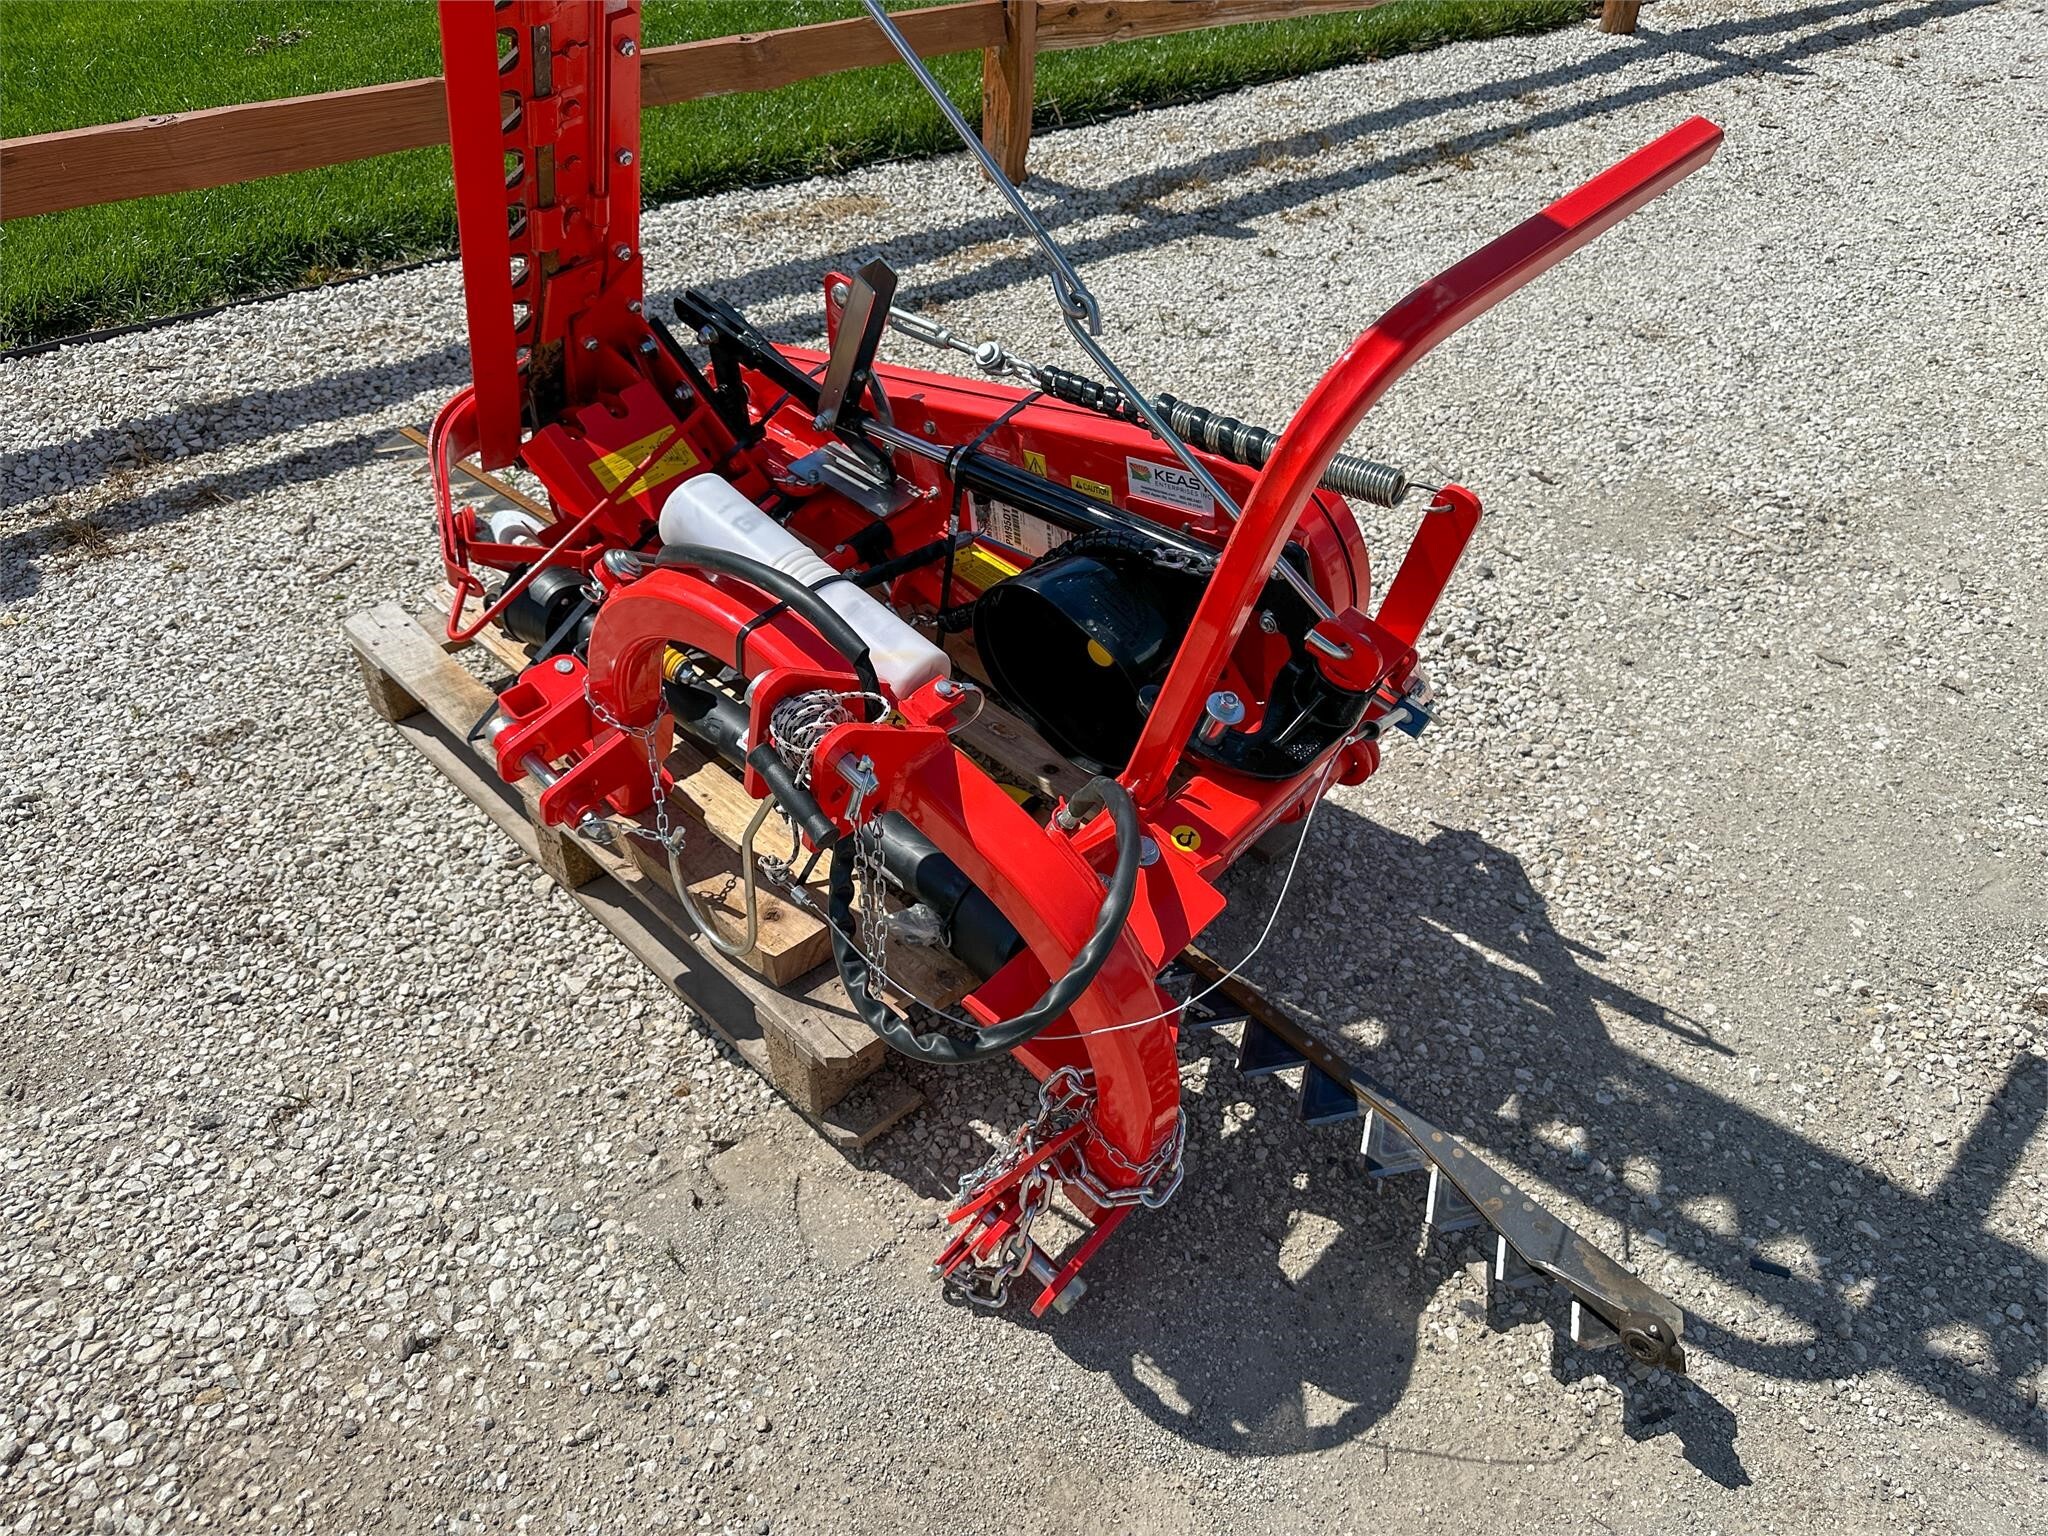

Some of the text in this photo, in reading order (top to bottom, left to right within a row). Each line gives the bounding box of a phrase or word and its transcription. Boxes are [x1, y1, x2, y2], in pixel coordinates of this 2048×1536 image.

[1083, 482, 1109, 497] CAUTION
[1154, 468, 1208, 492] KEAS
[1154, 480, 1199, 497] ENTERPRISES
[1002, 504, 1014, 546] PM95D1
